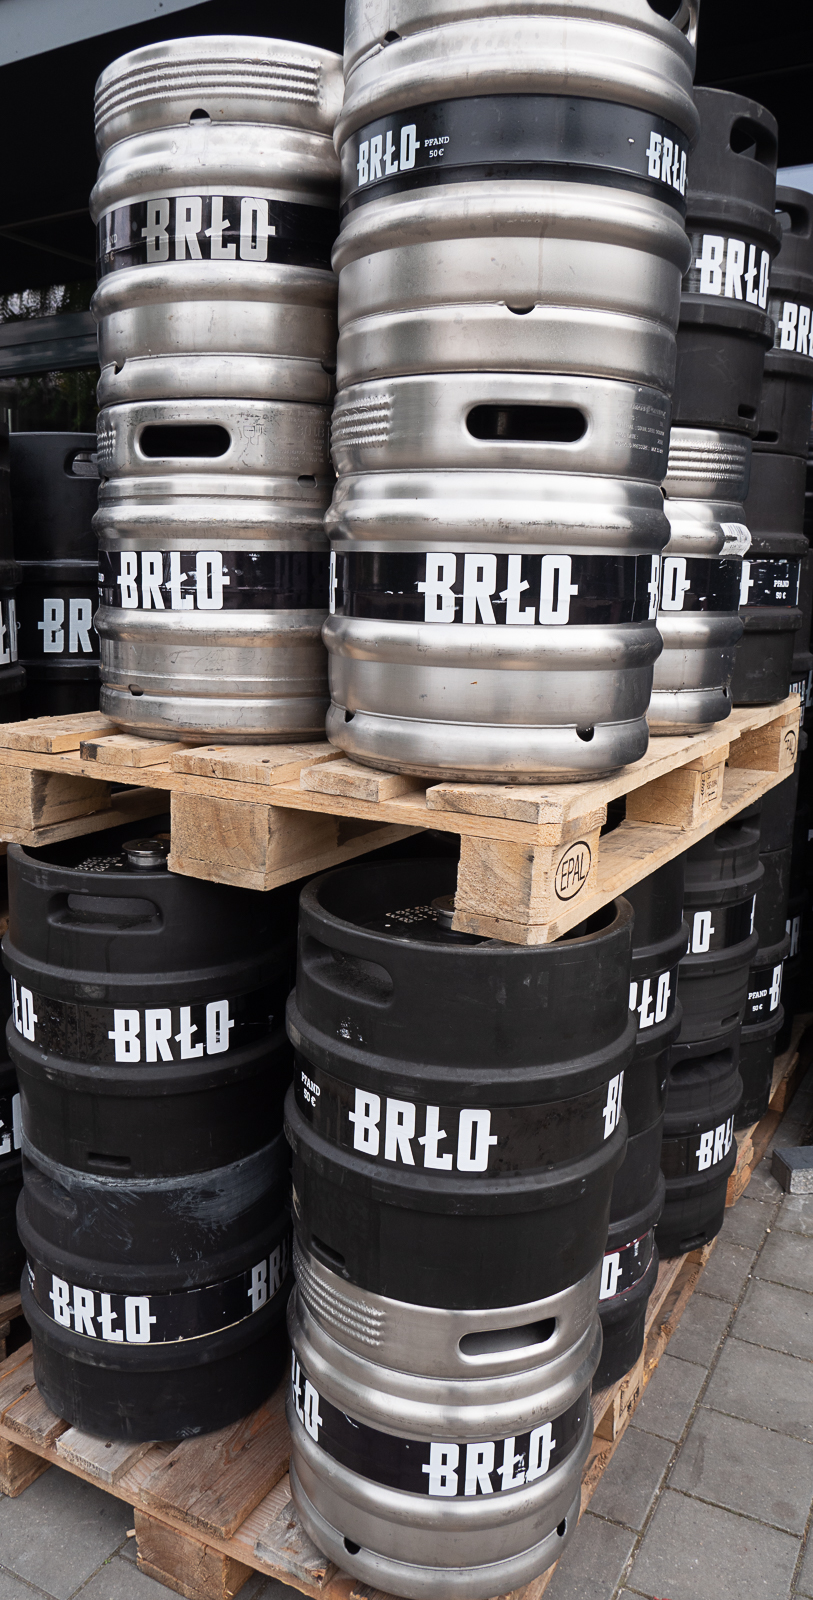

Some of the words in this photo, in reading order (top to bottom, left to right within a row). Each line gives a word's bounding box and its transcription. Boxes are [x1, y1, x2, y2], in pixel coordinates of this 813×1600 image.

[357, 125, 420, 187] BRŁO
[424, 136, 450, 147] PFAND
[646, 130, 688, 197] BRŁO
[141, 196, 275, 262] BRŁO
[695, 234, 770, 310] BRŁO
[117, 551, 230, 610] BRŁO
[418, 553, 578, 625] BRŁO
[560, 852, 586, 892] EPAL
[11, 975, 38, 1042] ŁO
[748, 989, 768, 1000] PFAND
[108, 999, 234, 1063] BRŁO
[349, 1087, 498, 1172] BRŁO
[695, 1114, 735, 1172] BRŁ
[49, 1274, 156, 1343] BRŁO
[422, 1422, 556, 1497] BRŁO
